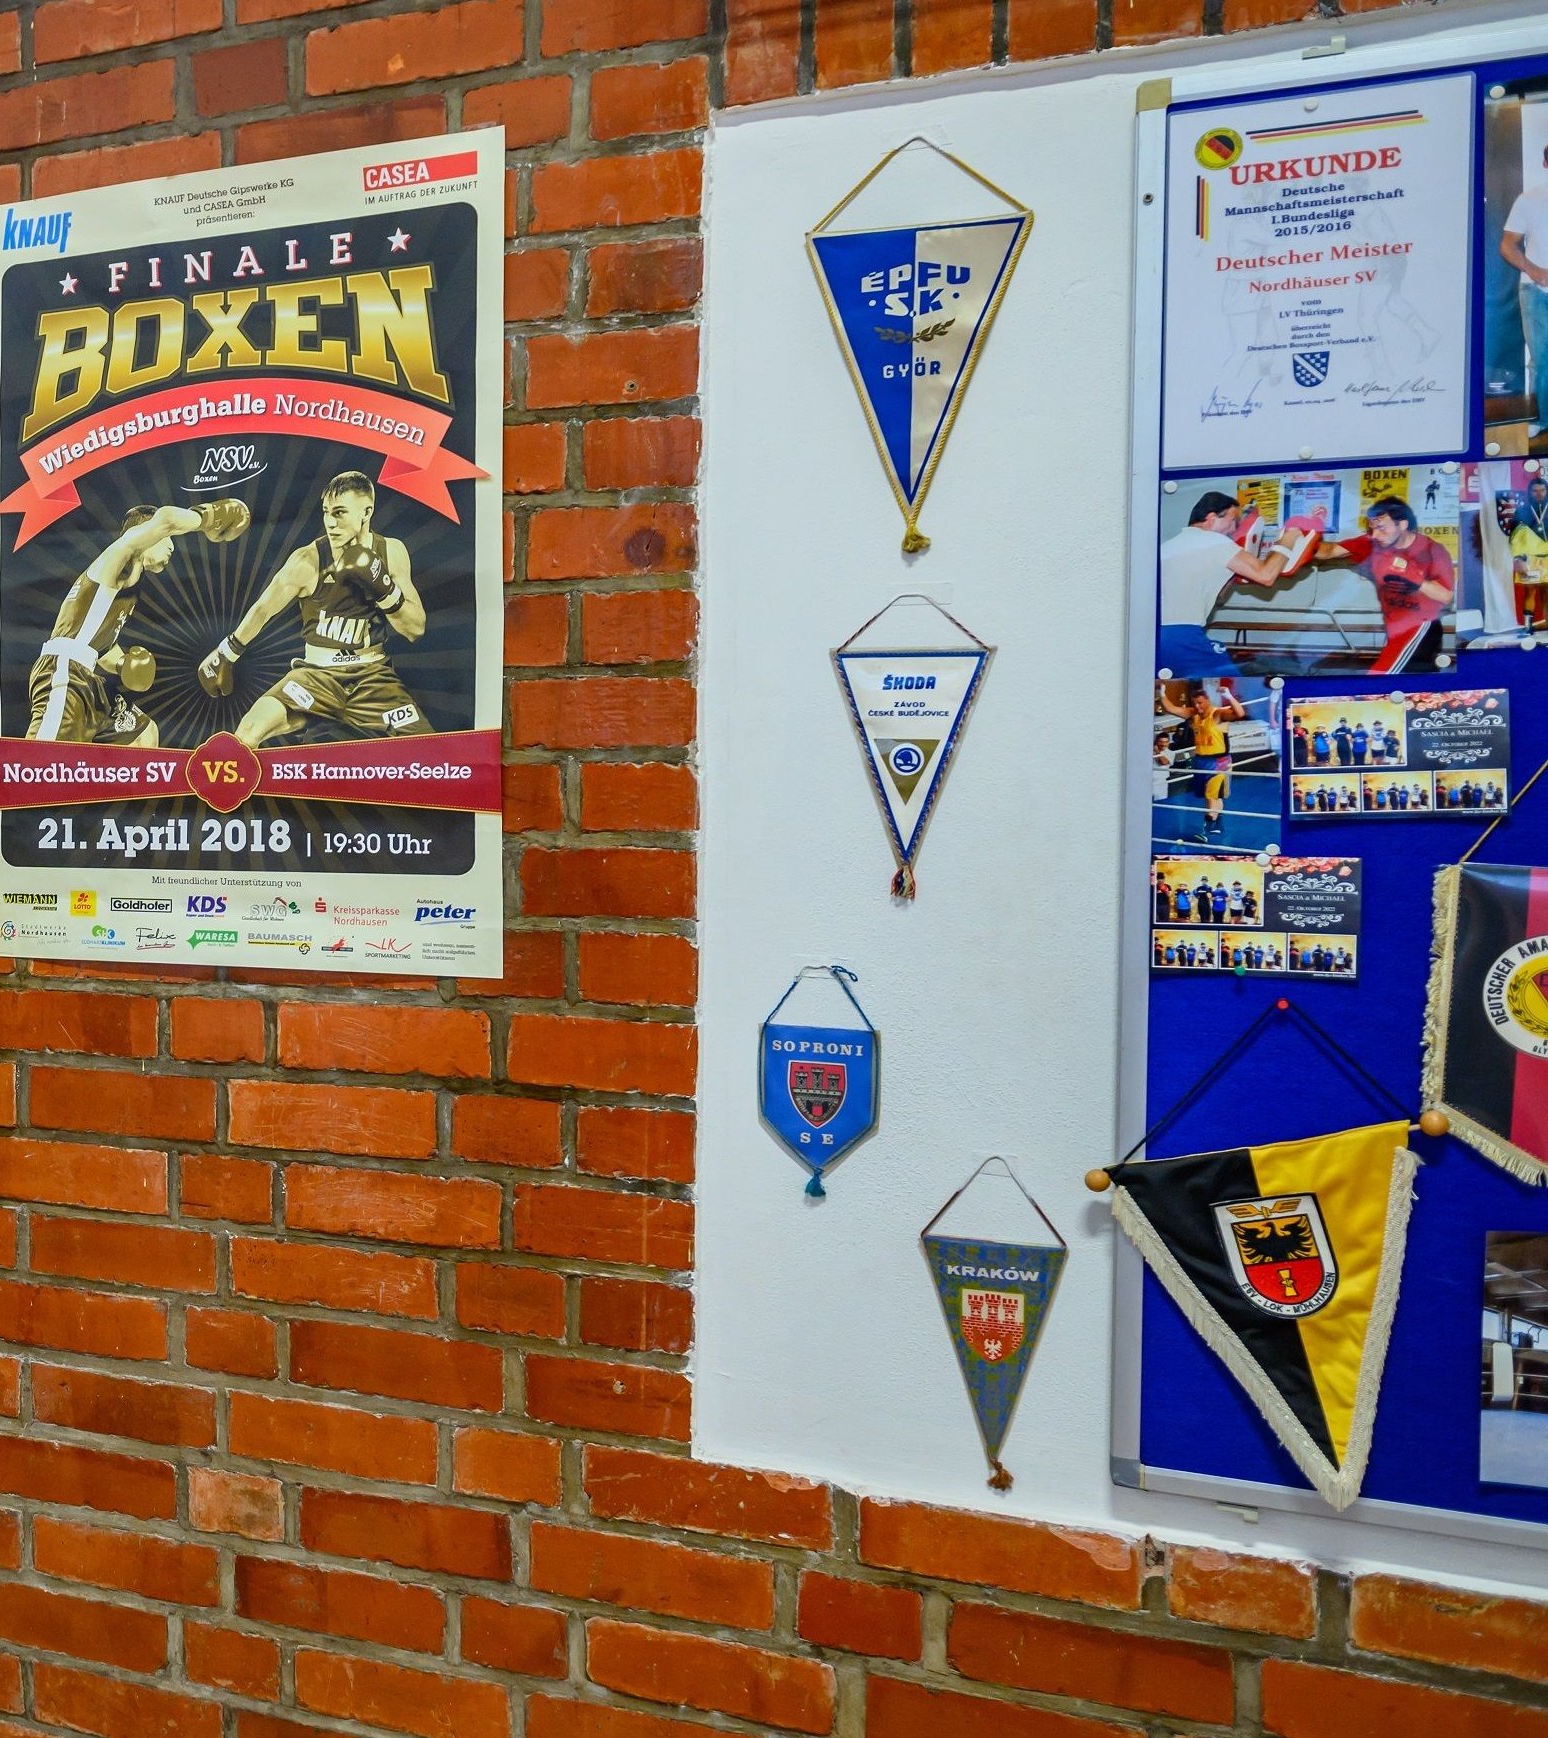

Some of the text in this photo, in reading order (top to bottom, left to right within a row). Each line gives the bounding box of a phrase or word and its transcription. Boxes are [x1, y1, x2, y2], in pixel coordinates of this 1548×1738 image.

[365, 161, 431, 189] CASEA
[1229, 147, 1402, 186] URKUNDE
[154, 178, 295, 206] KNAUF Deutsche Gipswerke KG
[364, 180, 479, 206] IM AUFTRAG DER ZUKUNFT
[1281, 182, 1345, 198] Deutsche
[183, 193, 267, 215] und CASEA GmbH
[1224, 187, 1405, 217] Mannschaftsmeisterschaft
[195, 210, 256, 227] präsentieren:
[1274, 221, 1352, 237] 2015/2016
[108, 231, 353, 294] FINALE
[1216, 241, 1414, 272] Deutscher Meister
[1249, 270, 1377, 294] Nordhäuser SV
[1279, 306, 1344, 319] LV Thüringen
[1291, 322, 1331, 332] überreicht
[1291, 332, 1313, 340] durch
[21, 265, 451, 443] BOXEN
[1247, 343, 1288, 352] Deutschen
[39, 393, 426, 476] Wiedigsburghalle Nordhausen
[200, 445, 255, 474] NSV
[193, 475, 218, 484] Boxen
[1363, 469, 1408, 480] BOXEN
[332, 655, 361, 663] adidas
[882, 674, 936, 690] ŠKODA
[387, 708, 413, 725] KDS
[868, 709, 950, 717] ČESKÉ BUDĚJOVICE
[3, 761, 177, 783] Nordhäuser SV
[202, 761, 245, 783] VS.
[271, 762, 472, 780] BSK Hannover-Seelze
[38, 817, 292, 858] 21. April 2018
[324, 833, 432, 855] 19:30 Uhr
[152, 876, 302, 889] Mit freundlicher Unterstützung von
[3, 893, 58, 905] WIEMANN
[113, 900, 170, 911] Goldhofer
[187, 896, 226, 913] KDS
[250, 904, 287, 917] SWG
[333, 905, 400, 916] Kreissparkasse
[414, 904, 477, 921] peter
[333, 917, 388, 927] Nordhausen
[135, 927, 177, 942] Felix
[195, 932, 236, 942] WARESA
[248, 933, 313, 942] BAUMASCH
[381, 938, 397, 950] LK
[1487, 957, 1517, 1026] DEUTSCHER
[772, 1039, 864, 1057] SOPRONI
[946, 1265, 1040, 1282] KRAKÓW
[1264, 1300, 1283, 1312] LOK
[1293, 1272, 1336, 1313] MÜHLHAUSEN
